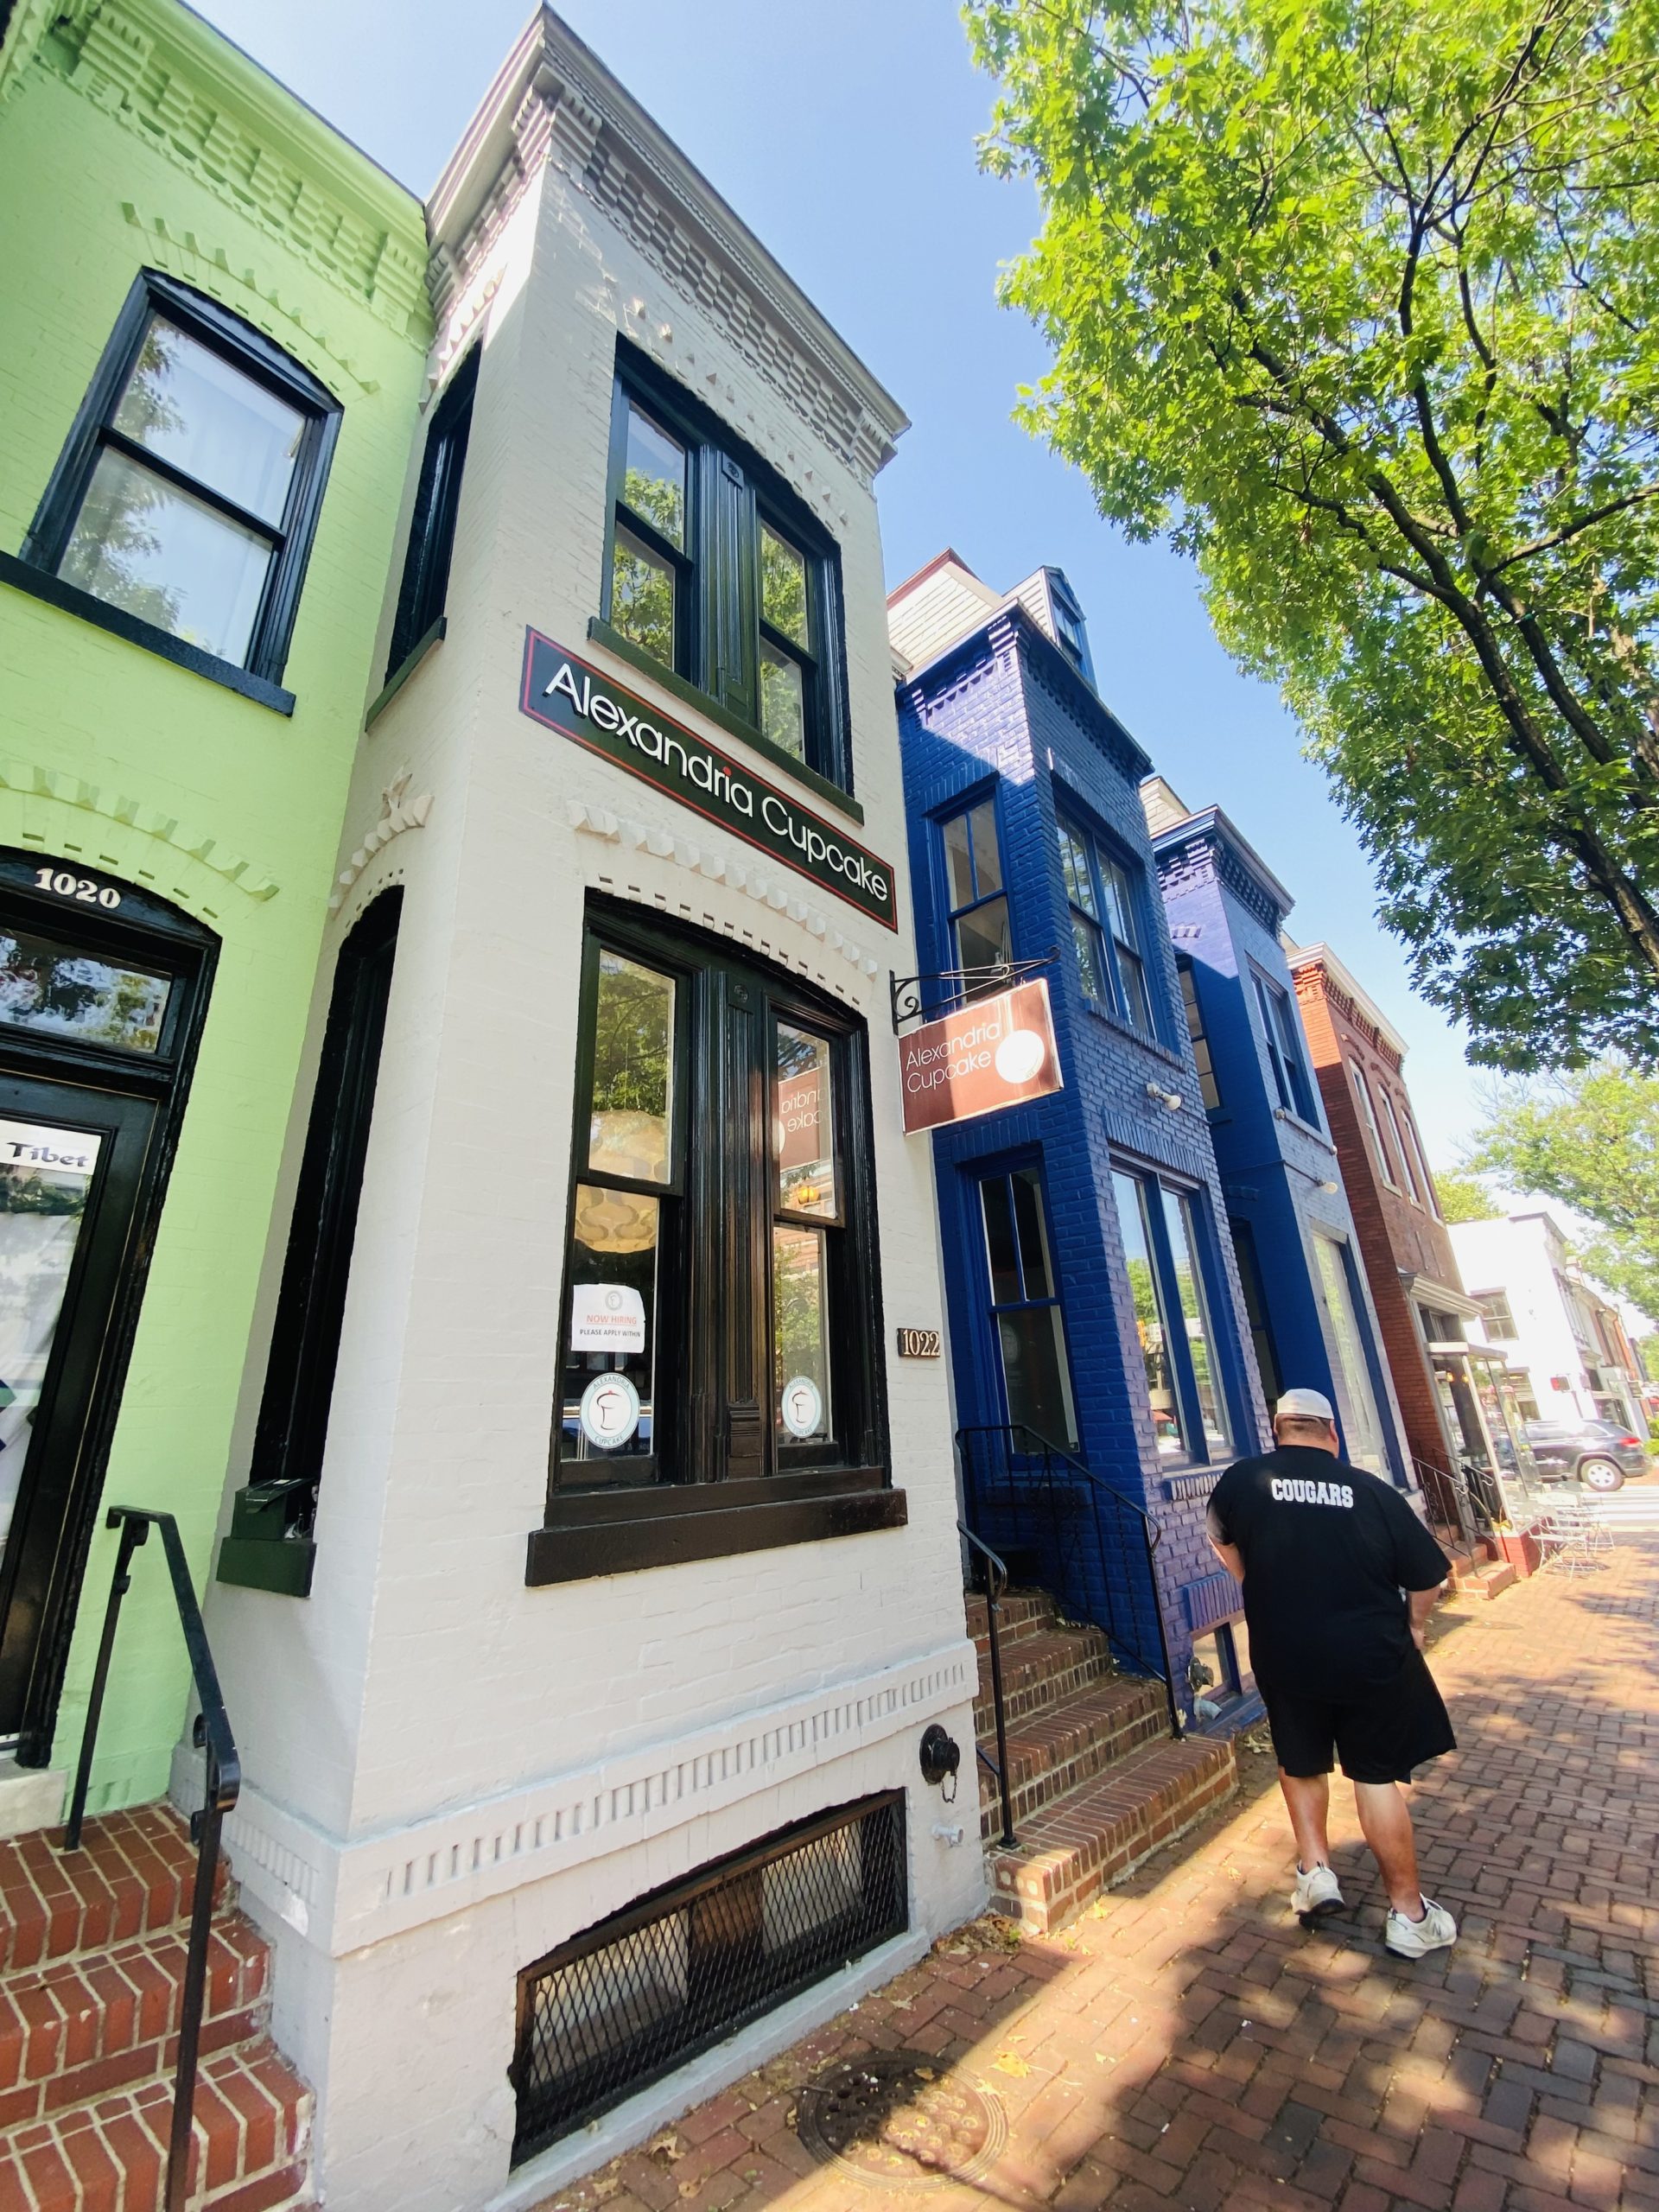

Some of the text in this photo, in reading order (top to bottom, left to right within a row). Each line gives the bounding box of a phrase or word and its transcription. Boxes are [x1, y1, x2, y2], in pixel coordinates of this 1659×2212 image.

[543, 663, 888, 902] Alexandria Cupcake
[35, 868, 121, 909] 1020
[906, 1021, 1001, 1071] Alexandria
[906, 1051, 992, 1093] Cupcake
[6, 1141, 89, 1167] Tibet
[587, 1314, 637, 1325] NOW HIRING
[903, 1329, 940, 1356] 1022
[593, 1376, 630, 1389] ALEXANDRIA
[594, 1434, 624, 1446] CUPCAKE
[1271, 1478, 1354, 1509] COUGARS
